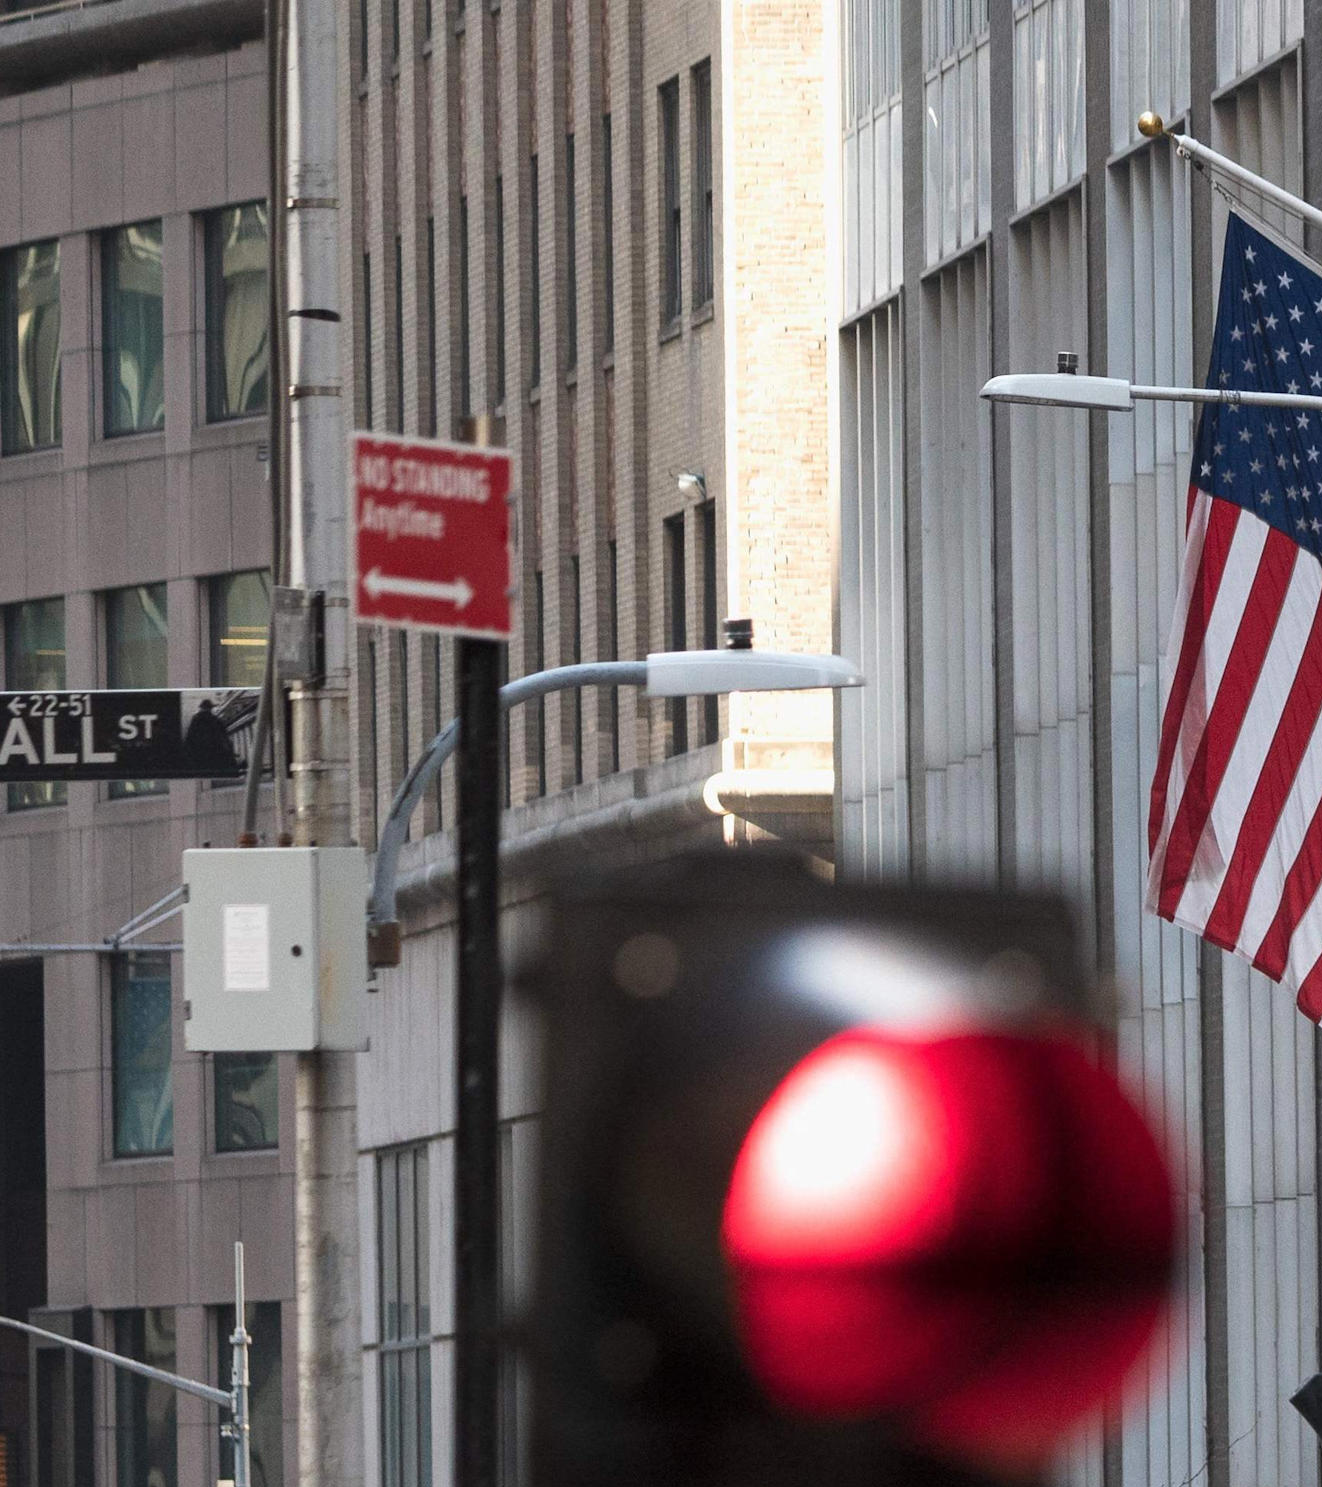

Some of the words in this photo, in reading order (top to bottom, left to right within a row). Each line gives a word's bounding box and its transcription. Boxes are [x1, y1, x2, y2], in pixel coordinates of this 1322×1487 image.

[360, 455, 389, 491] NO
[391, 459, 490, 504] STANDING
[361, 497, 445, 541] Anytime
[29, 694, 92, 716] 22-51
[118, 714, 158, 740] ST
